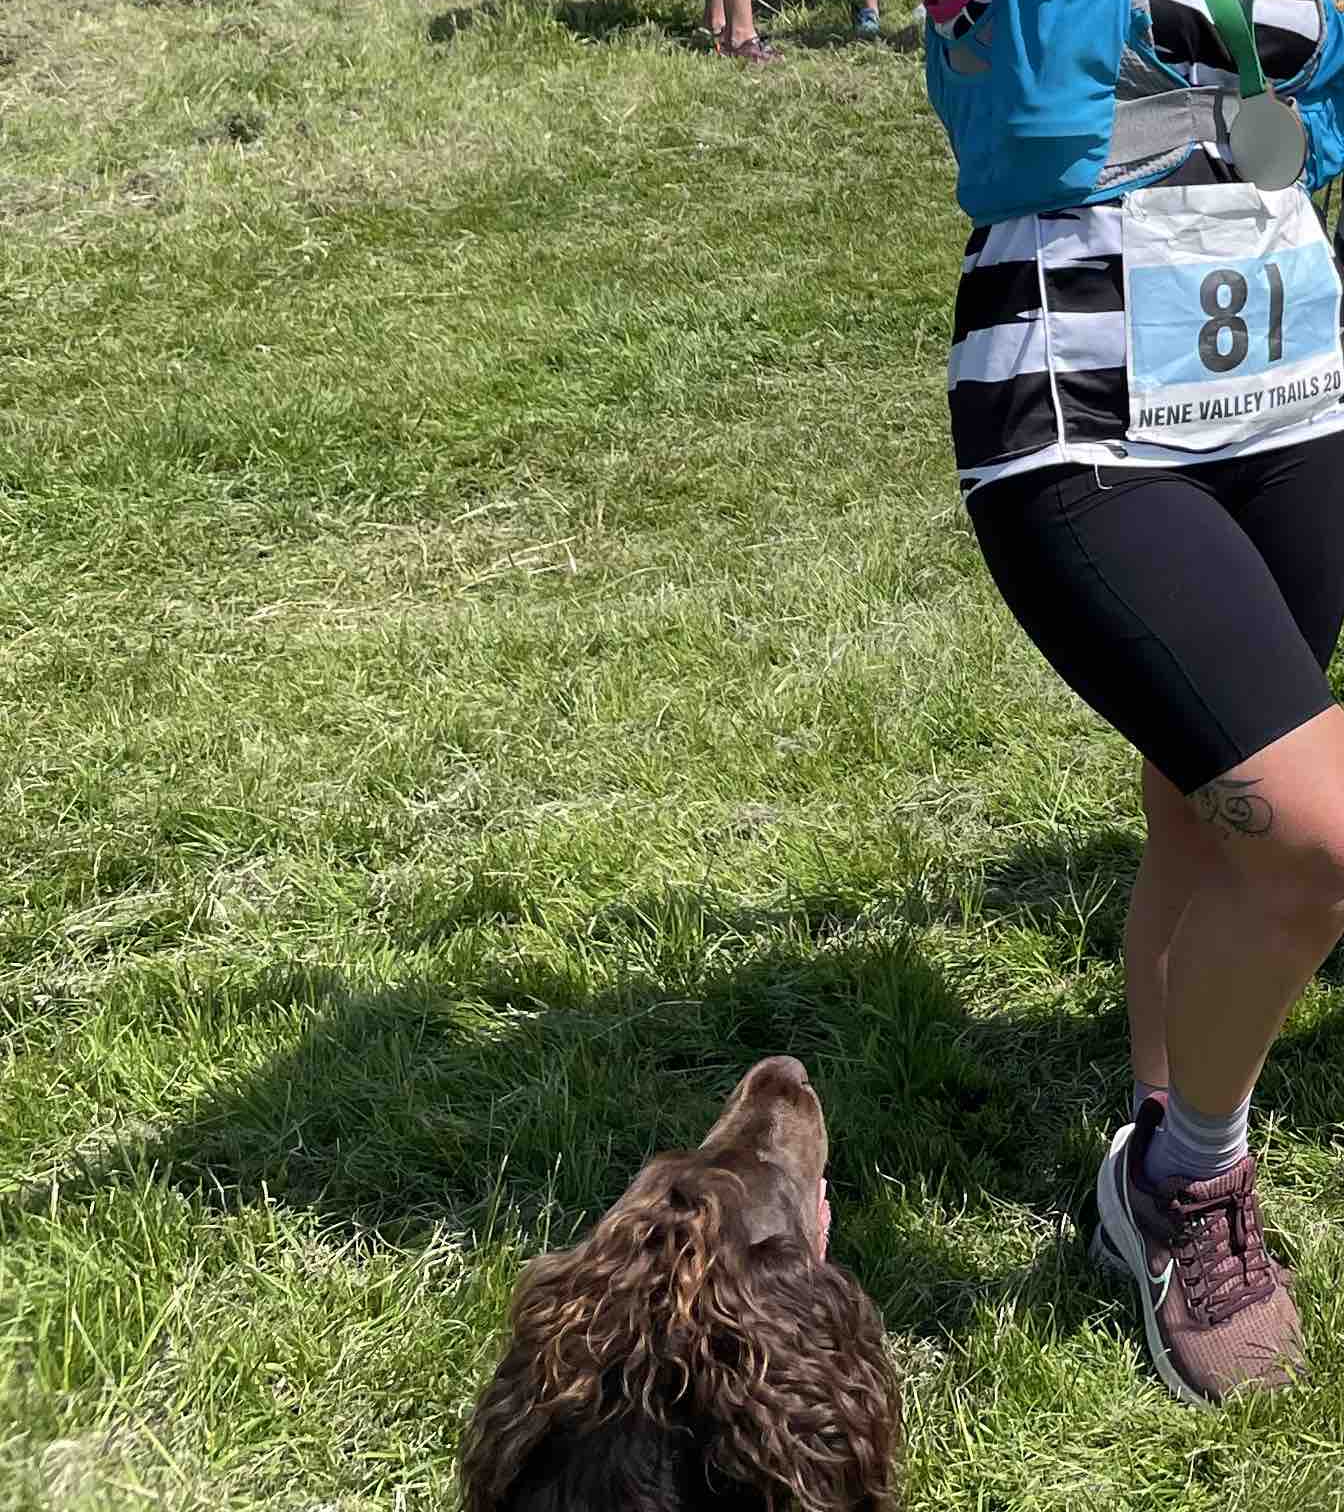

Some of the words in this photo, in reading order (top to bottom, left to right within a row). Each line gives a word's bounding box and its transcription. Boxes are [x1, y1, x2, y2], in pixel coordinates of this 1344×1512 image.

[1198, 263, 1285, 373] 81
[1138, 403, 1193, 428] NENE
[1199, 390, 1264, 421] VALLEY
[1269, 375, 1319, 409] TRAILS
[1322, 370, 1341, 392] 20
